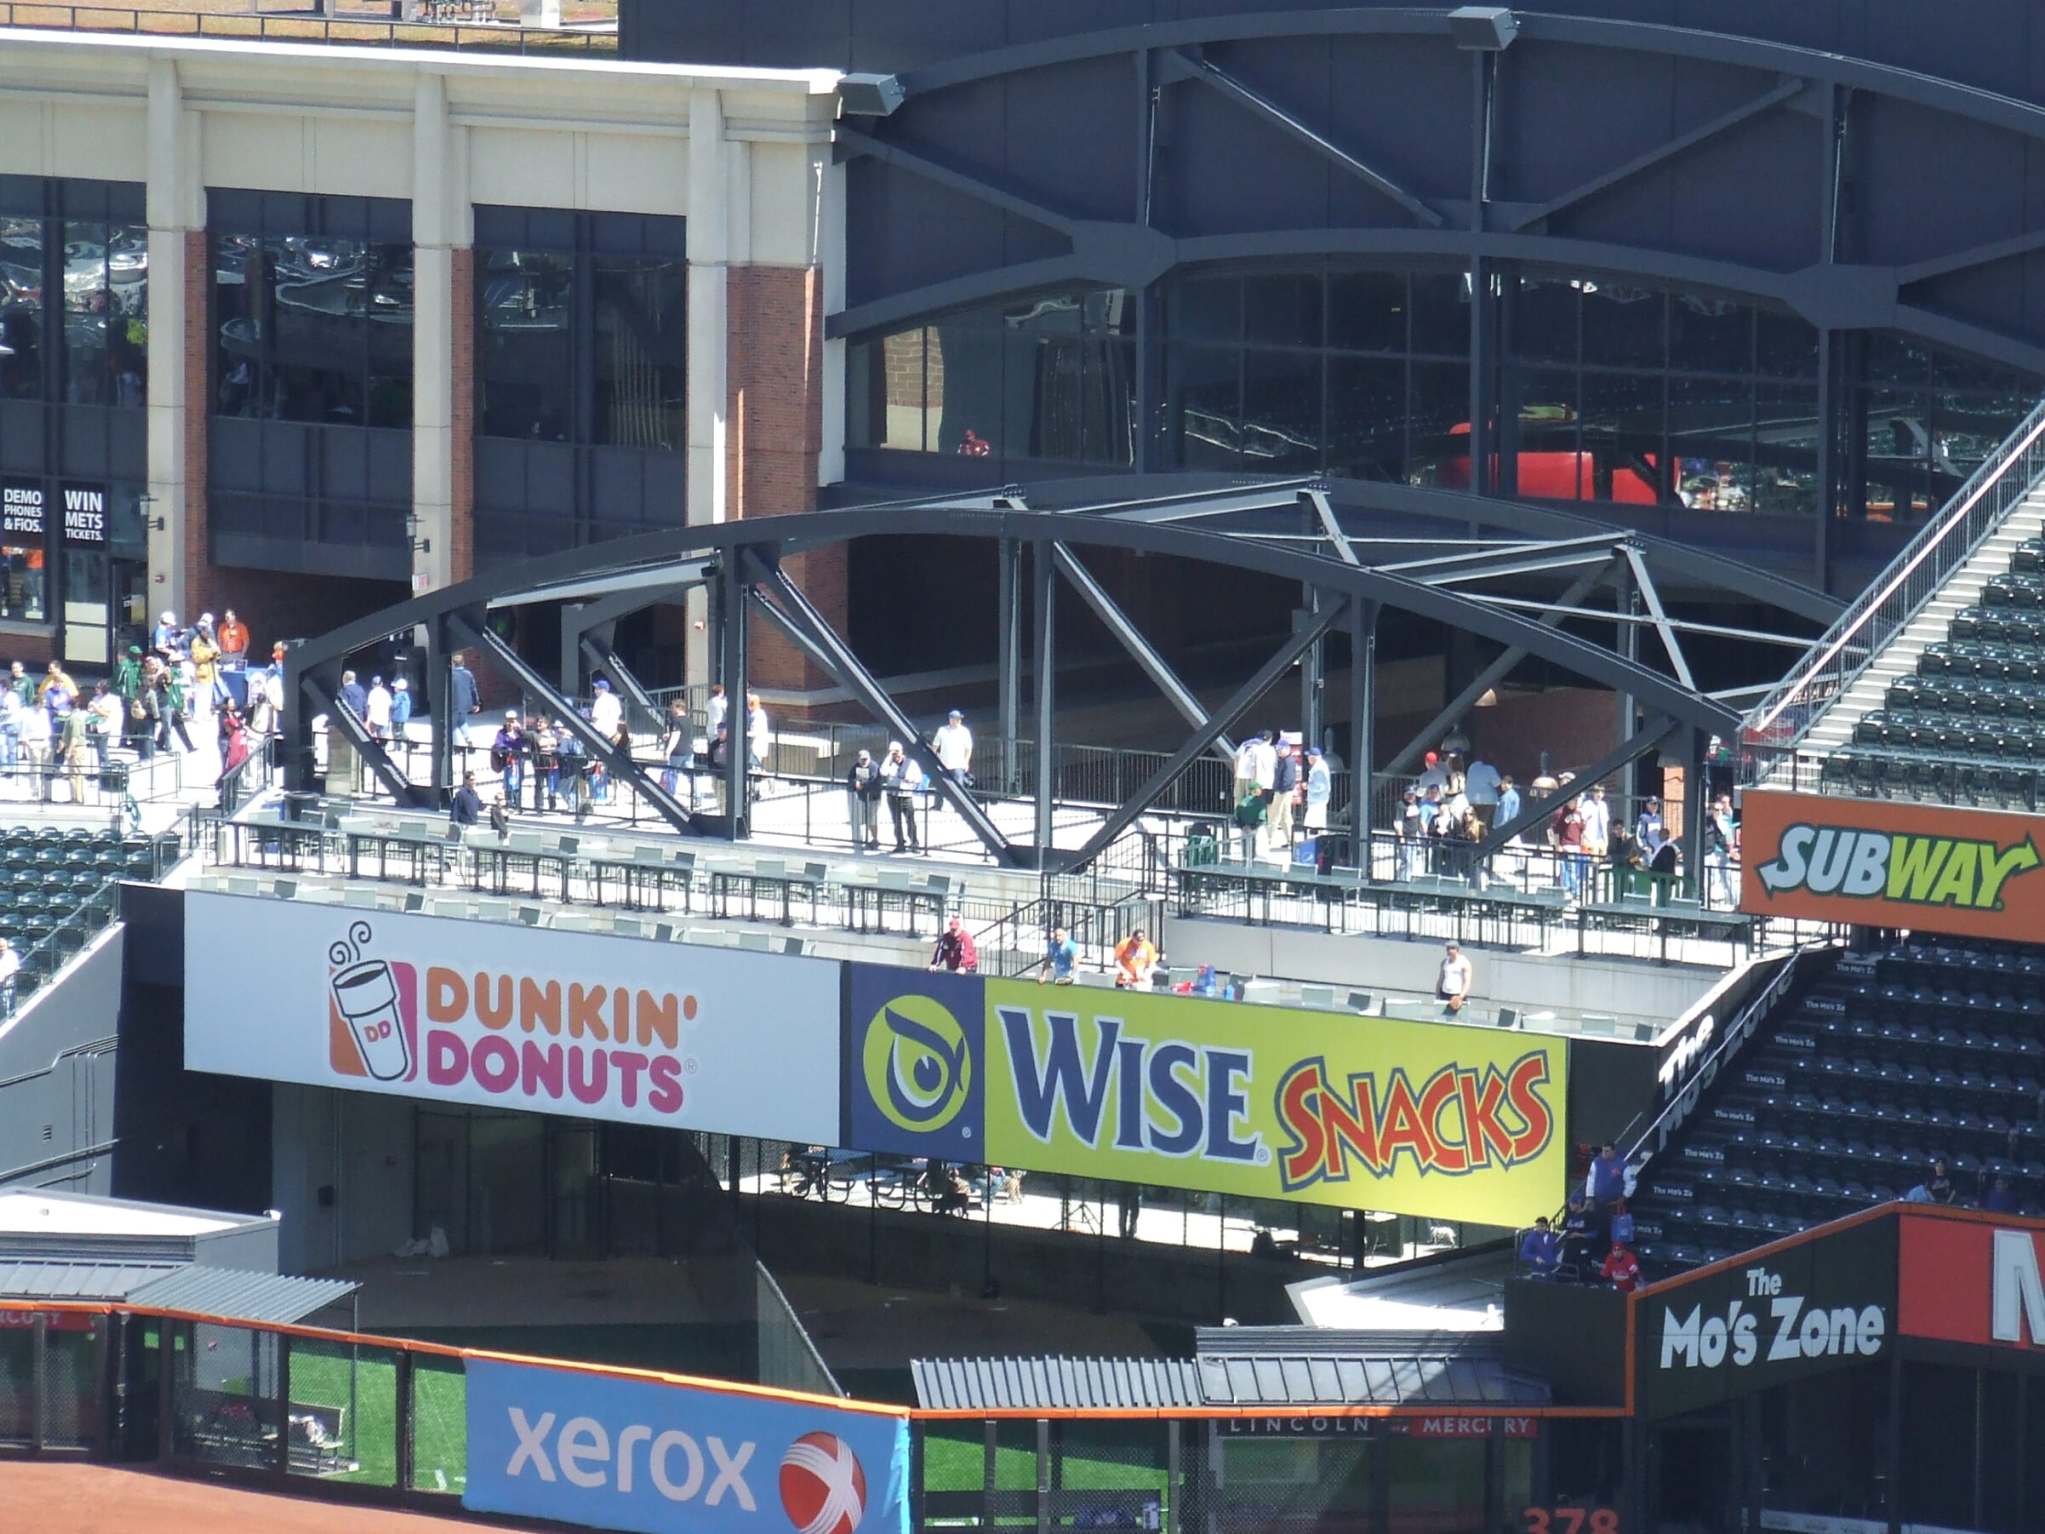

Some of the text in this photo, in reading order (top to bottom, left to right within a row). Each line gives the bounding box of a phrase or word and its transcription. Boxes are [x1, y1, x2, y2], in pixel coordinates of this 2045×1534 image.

[4, 488, 42, 505] DEMO
[64, 490, 103, 512] WIN
[4, 504, 43, 518] PHONES
[4, 517, 13, 530] &
[64, 511, 103, 529] METS
[64, 527, 104, 541] TICKETS.
[1755, 822, 2042, 911] SUBWAY
[426, 966, 698, 1049] DUNKIN'
[364, 1019, 392, 1043] DD
[1658, 1015, 1714, 1100] The
[426, 1029, 684, 1114] DONUTS
[994, 1004, 1554, 1193] WISE SNACKS
[1746, 1267, 1783, 1297] The
[1660, 1296, 1885, 1369] Mo's Zone
[1230, 1418, 1370, 1433] LINCOLN
[506, 1407, 758, 1512] xerox
